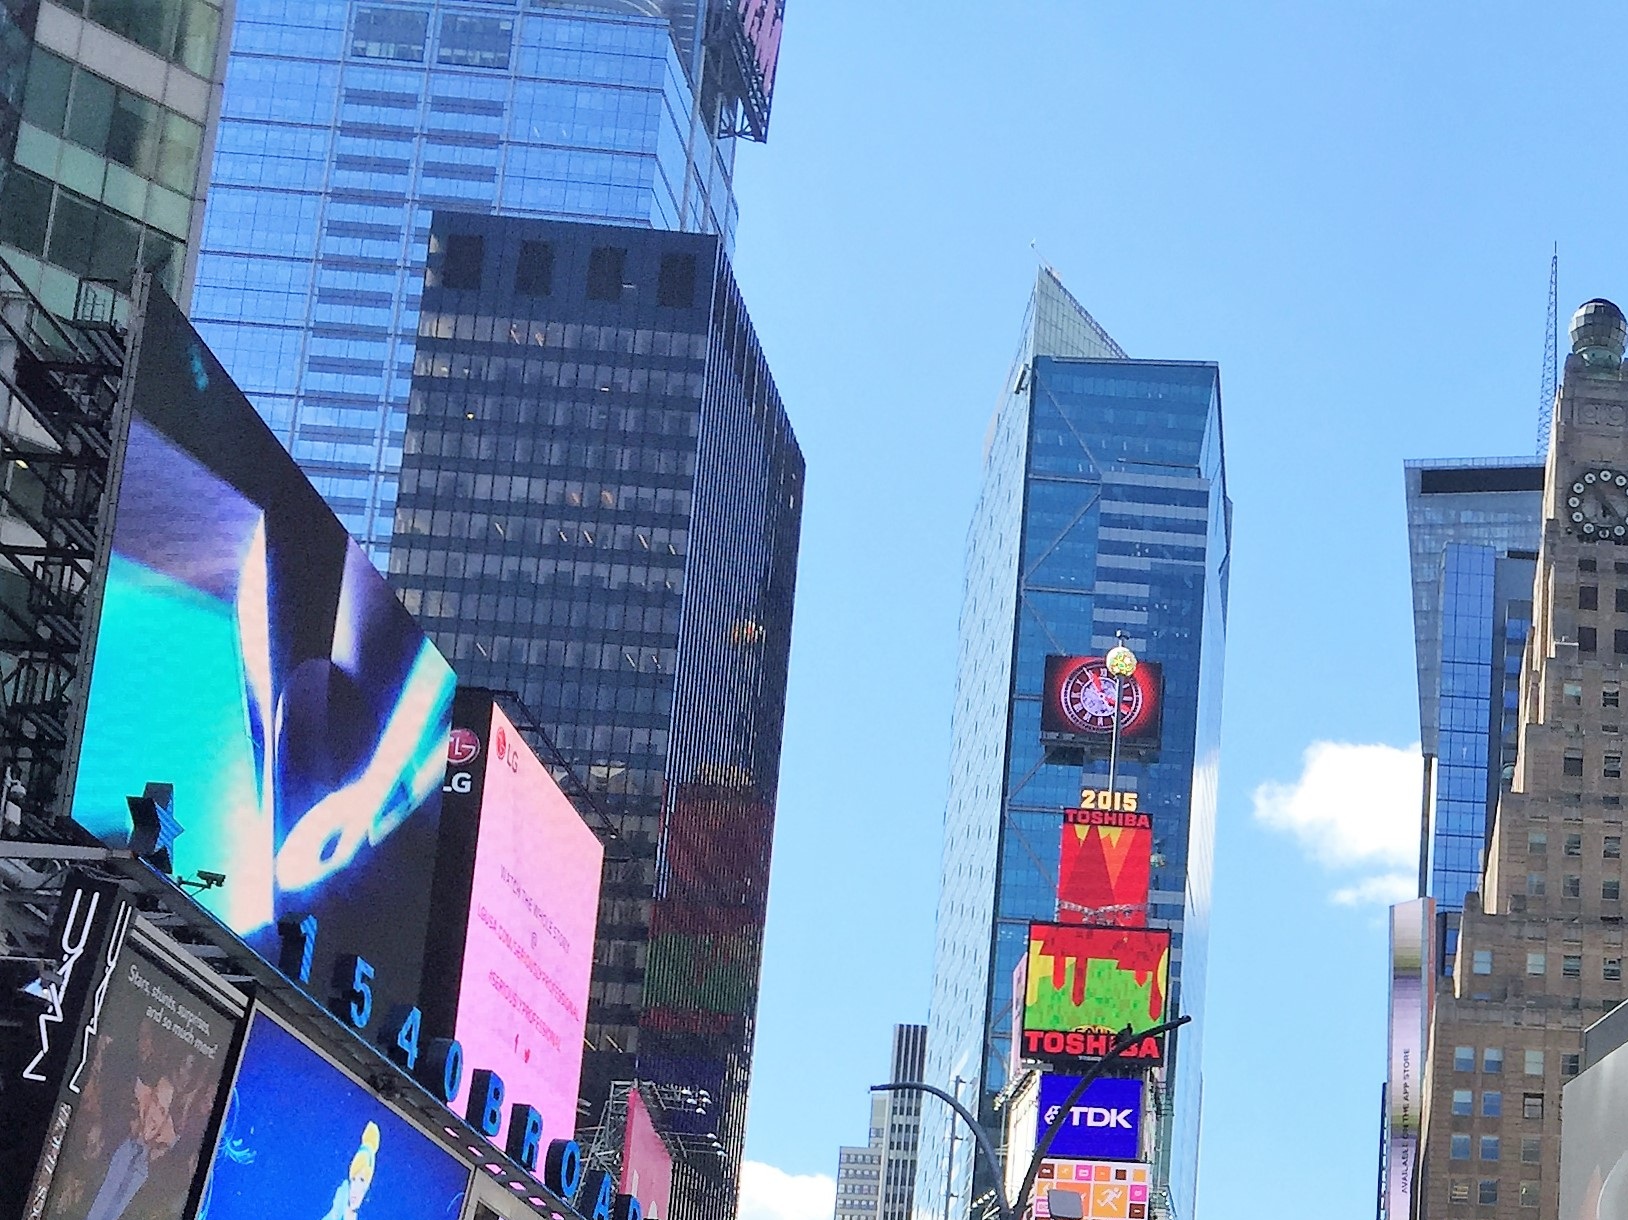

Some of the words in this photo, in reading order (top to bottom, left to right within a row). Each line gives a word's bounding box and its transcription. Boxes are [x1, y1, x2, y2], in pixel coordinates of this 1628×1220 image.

[1081, 789, 1138, 811] 2015
[1066, 809, 1150, 828] TOSHIBA
[1069, 1107, 1133, 1129] TDK
